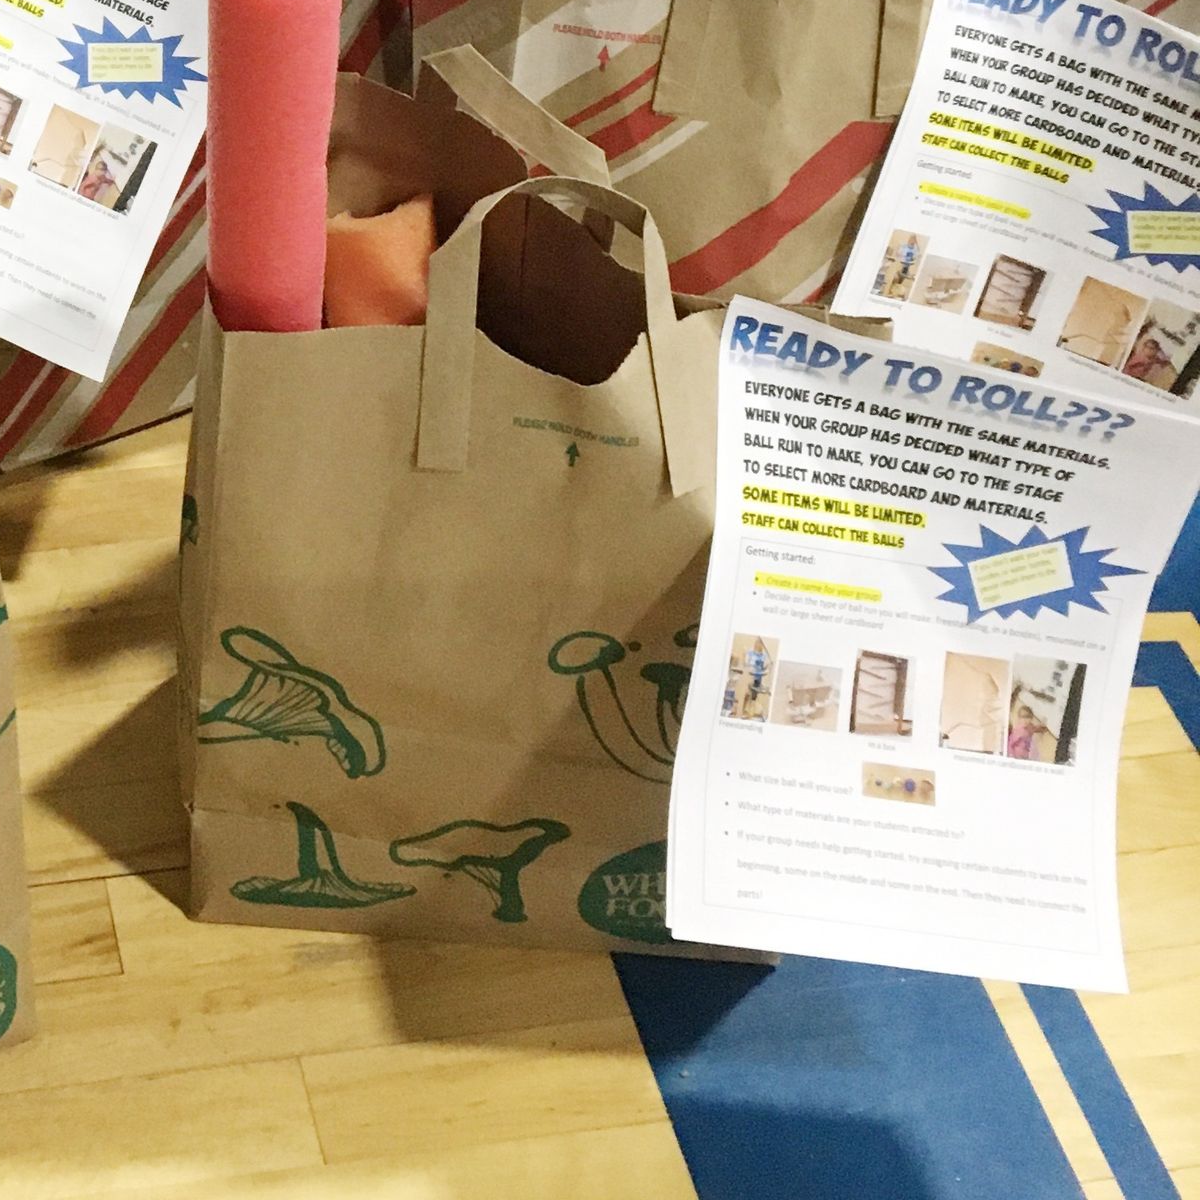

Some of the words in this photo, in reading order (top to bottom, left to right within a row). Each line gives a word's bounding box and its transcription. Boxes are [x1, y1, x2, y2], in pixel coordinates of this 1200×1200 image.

[1075, 3, 1126, 47] TO
[732, 315, 873, 376] READY
[884, 359, 942, 394] TO
[951, 375, 1135, 439] ROLL???
[745, 381, 810, 403] EVERYONE
[813, 392, 852, 410] GETS
[854, 401, 865, 413] A
[869, 404, 901, 421] BAG
[905, 412, 943, 430] WITH
[947, 421, 975, 437] THE
[977, 430, 1021, 448] SAME
[1022, 440, 1109, 469] MATERIALS.
[745, 407, 780, 424] WHEN
[784, 413, 817, 430] YOUR
[820, 419, 868, 438] GROUP
[870, 428, 901, 445] HAS
[903, 435, 964, 457] DECIDED
[968, 449, 1012, 468] WHAT
[1015, 460, 1052, 477] TYPE
[1054, 469, 1075, 482] OF
[743, 459, 760, 474] TO
[764, 463, 807, 481] SELECT
[811, 471, 846, 488] MORE
[849, 476, 927, 501] CARDBOARD
[930, 491, 961, 507] AND
[963, 497, 1047, 524] MATERIALS.
[744, 433, 774, 449] BALL
[778, 438, 802, 454] RUN
[806, 443, 823, 458] TO
[826, 447, 863, 466] MAKE,
[870, 454, 898, 470] YOU
[901, 459, 930, 476] CAN
[933, 466, 955, 481] GO
[960, 471, 979, 486] TO
[983, 475, 1011, 491] THE
[1014, 483, 1064, 503] STAGE
[741, 512, 775, 527] STAFF
[778, 518, 799, 532] CAN
[802, 521, 846, 539] COLLECT
[849, 529, 869, 543] THE
[872, 532, 905, 549] BALLS
[742, 486, 778, 503] SOME
[782, 492, 820, 510] ITEMS
[824, 499, 850, 515] WILL
[854, 503, 869, 518] BE
[872, 507, 925, 528] LIMITED.
[745, 545, 779, 562] Getting
[781, 552, 814, 565] started:
